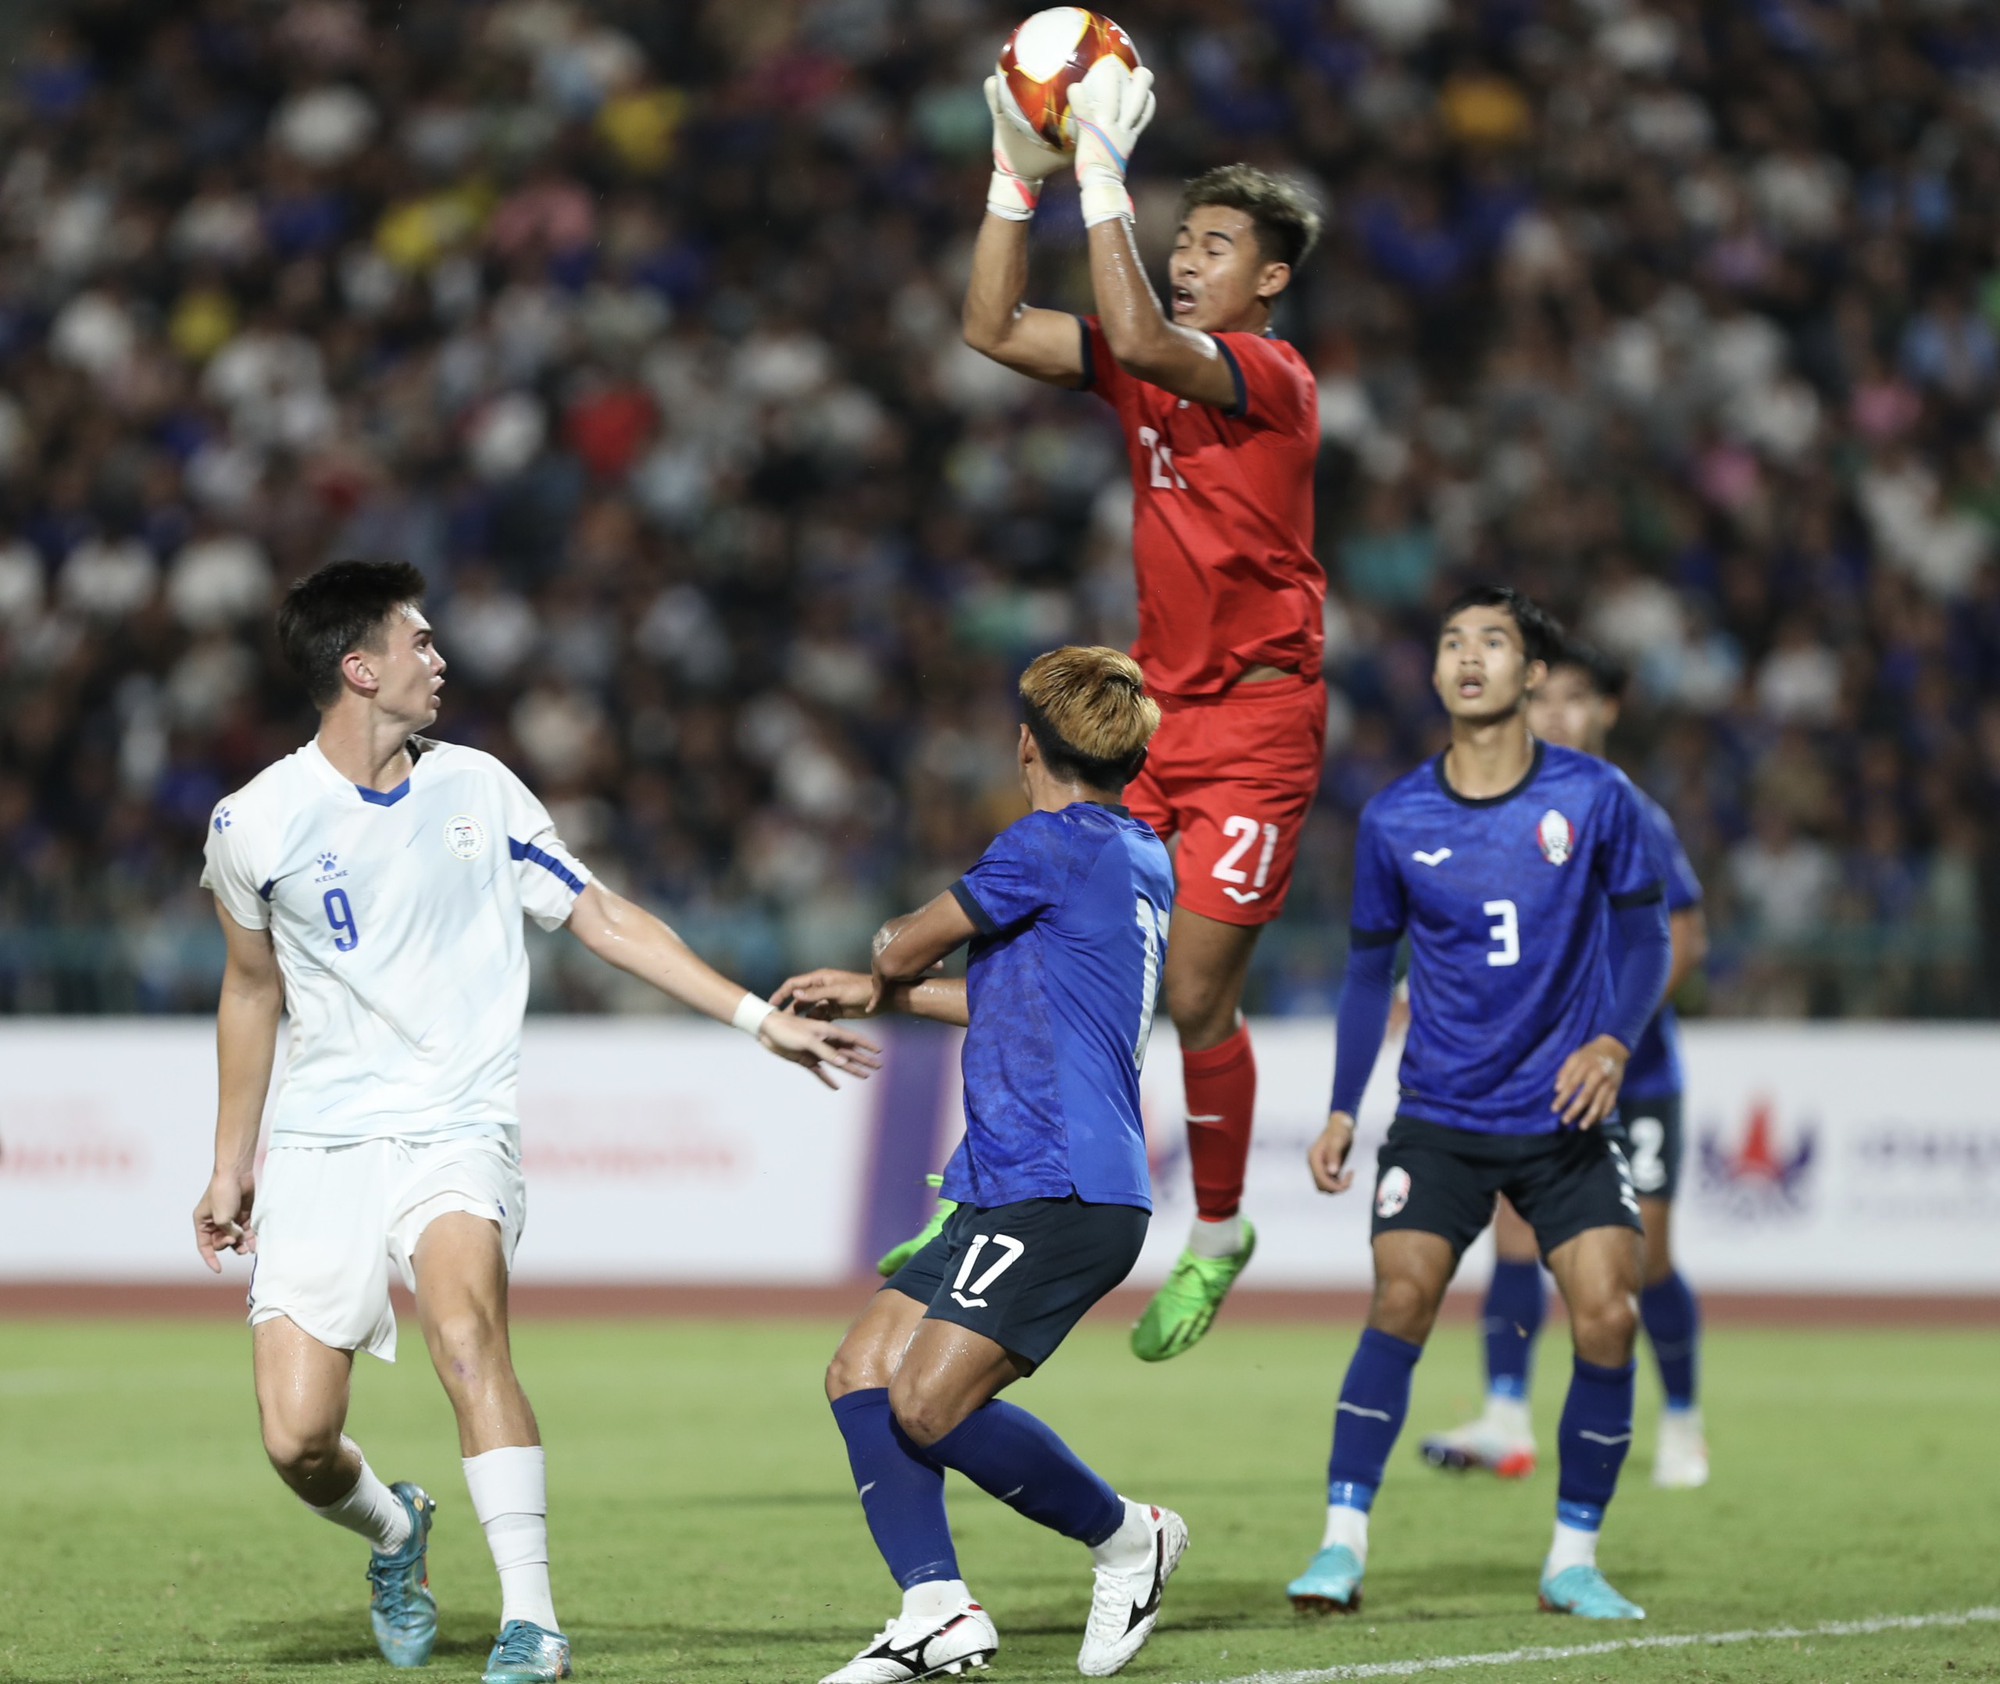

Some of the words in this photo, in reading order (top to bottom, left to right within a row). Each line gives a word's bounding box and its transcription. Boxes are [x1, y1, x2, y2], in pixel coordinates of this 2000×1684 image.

[315, 869, 349, 883] KELME
[1211, 814, 1279, 889] 21
[323, 887, 358, 952] 9
[1483, 899, 1520, 967] 3
[953, 1233, 1025, 1295] 17
